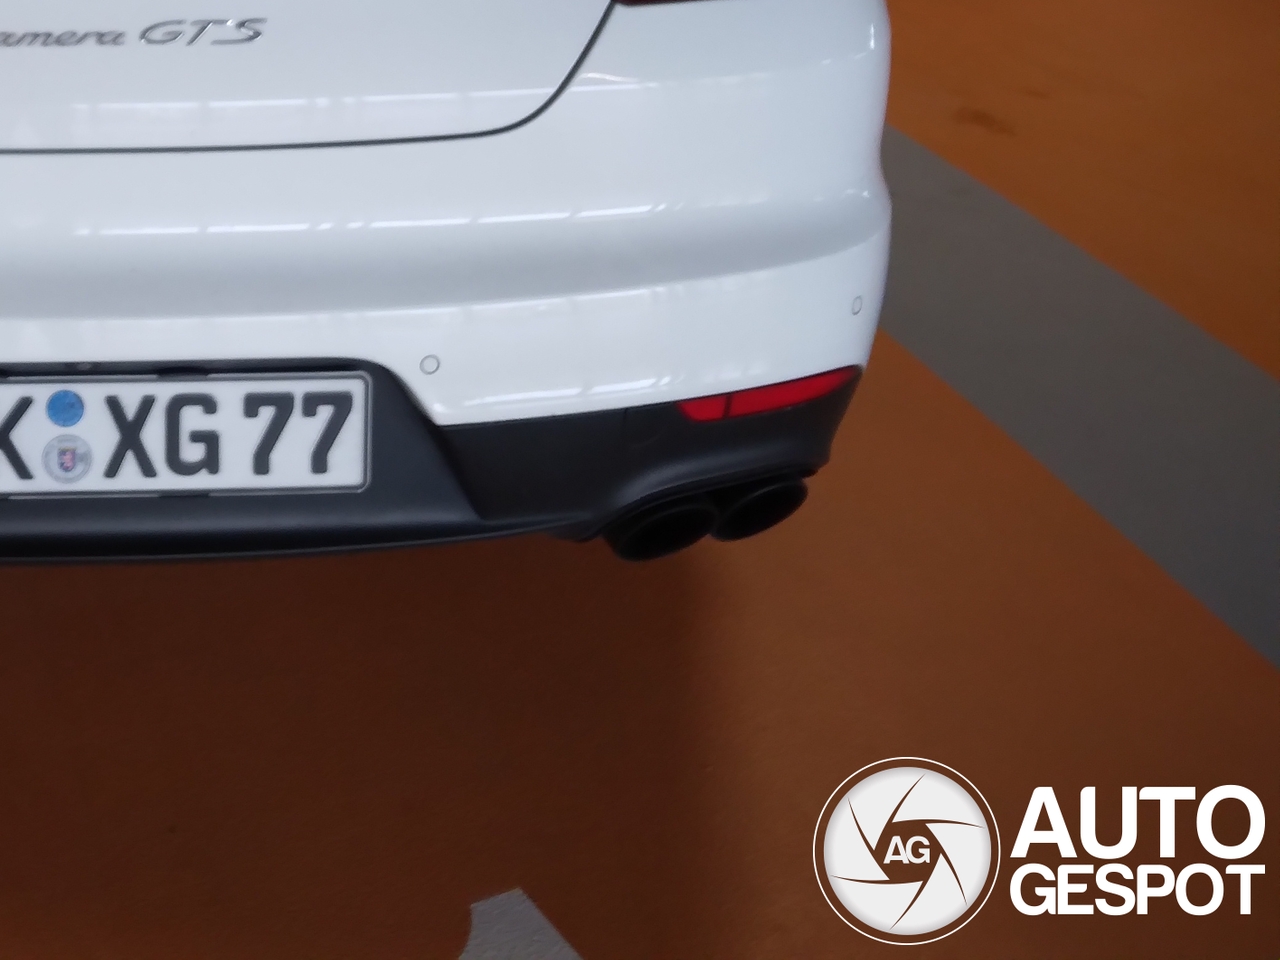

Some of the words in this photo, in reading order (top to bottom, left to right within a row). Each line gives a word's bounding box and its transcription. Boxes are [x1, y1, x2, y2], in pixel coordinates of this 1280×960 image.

[138, 17, 268, 47] GTS
[104, 392, 220, 478] XG
[243, 391, 354, 475] 77
